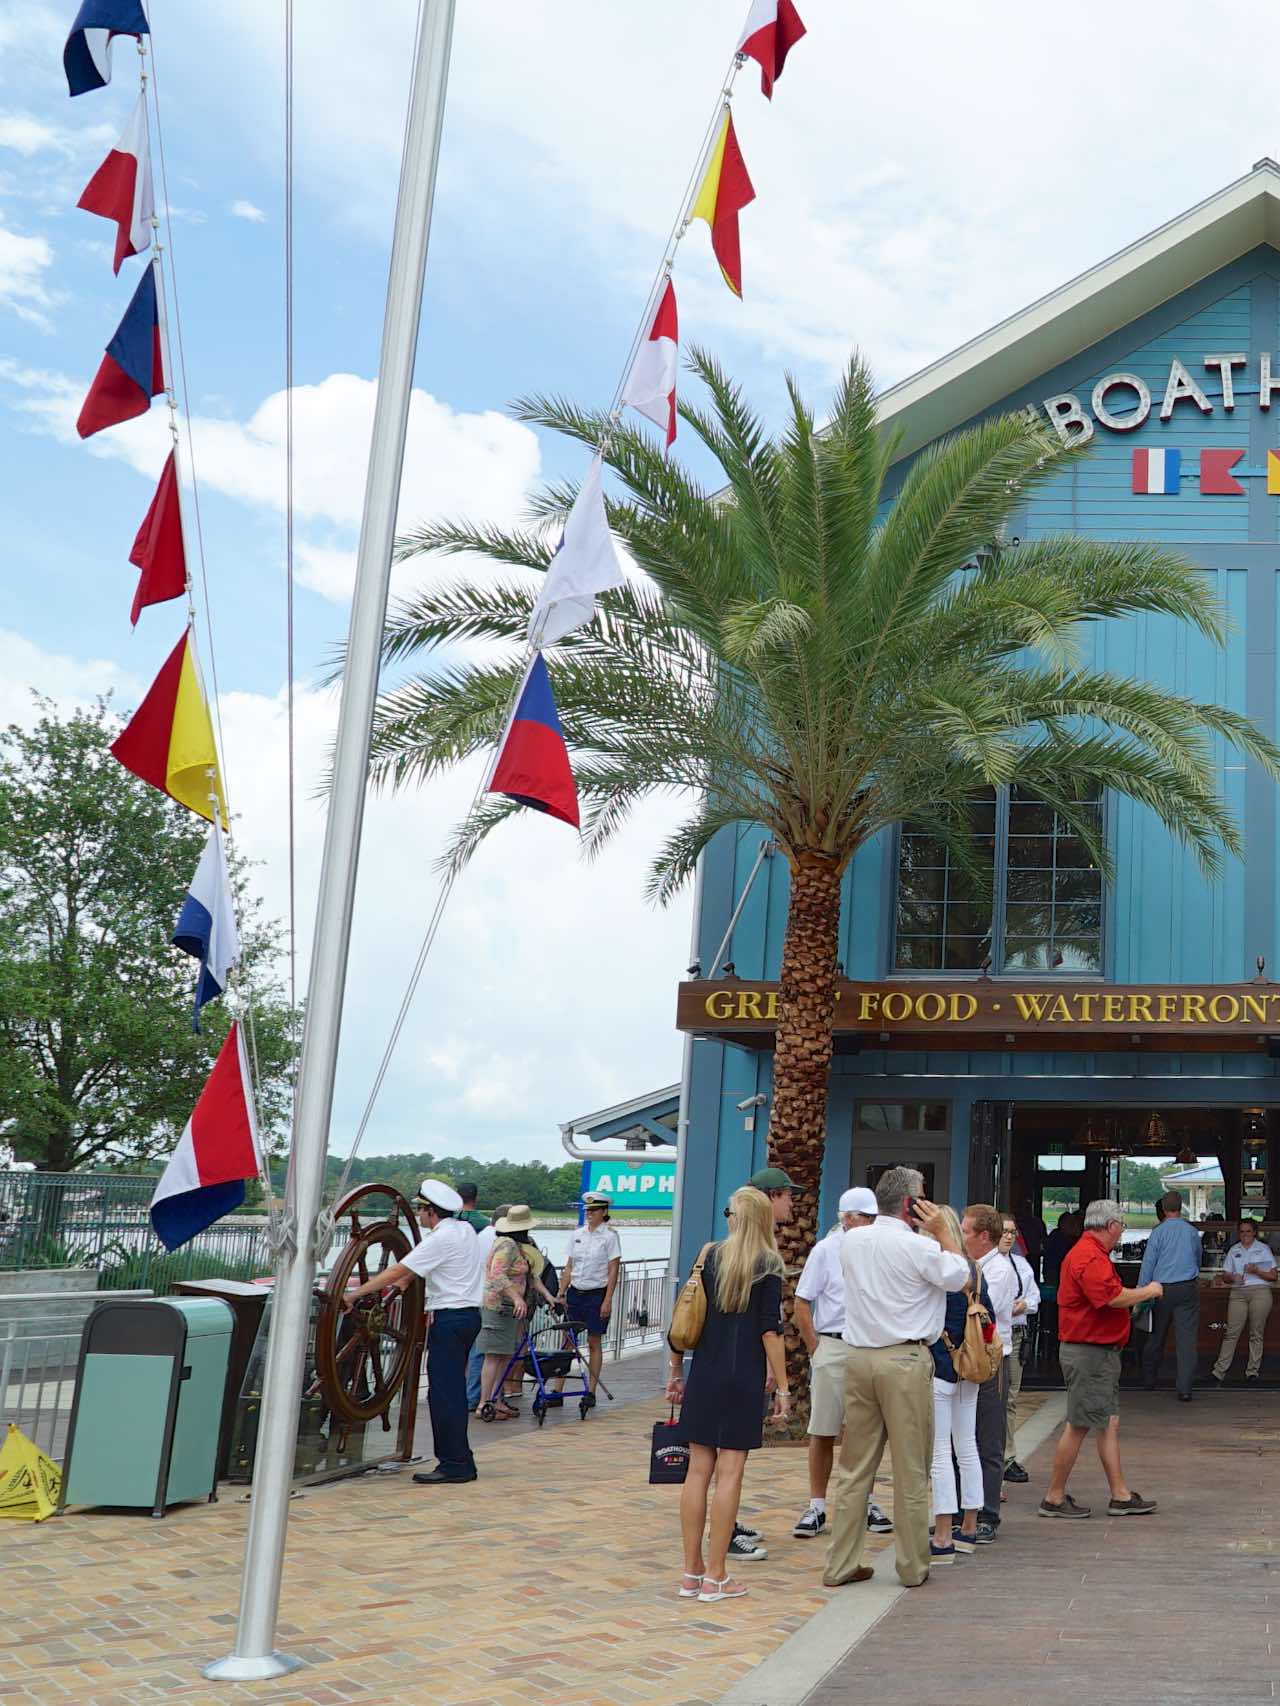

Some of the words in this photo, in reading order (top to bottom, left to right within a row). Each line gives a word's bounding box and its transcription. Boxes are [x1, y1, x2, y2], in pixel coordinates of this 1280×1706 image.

[704, 990, 841, 1020] GRE
[857, 991, 979, 1022] FOOD
[595, 1174, 675, 1193] AMPH
